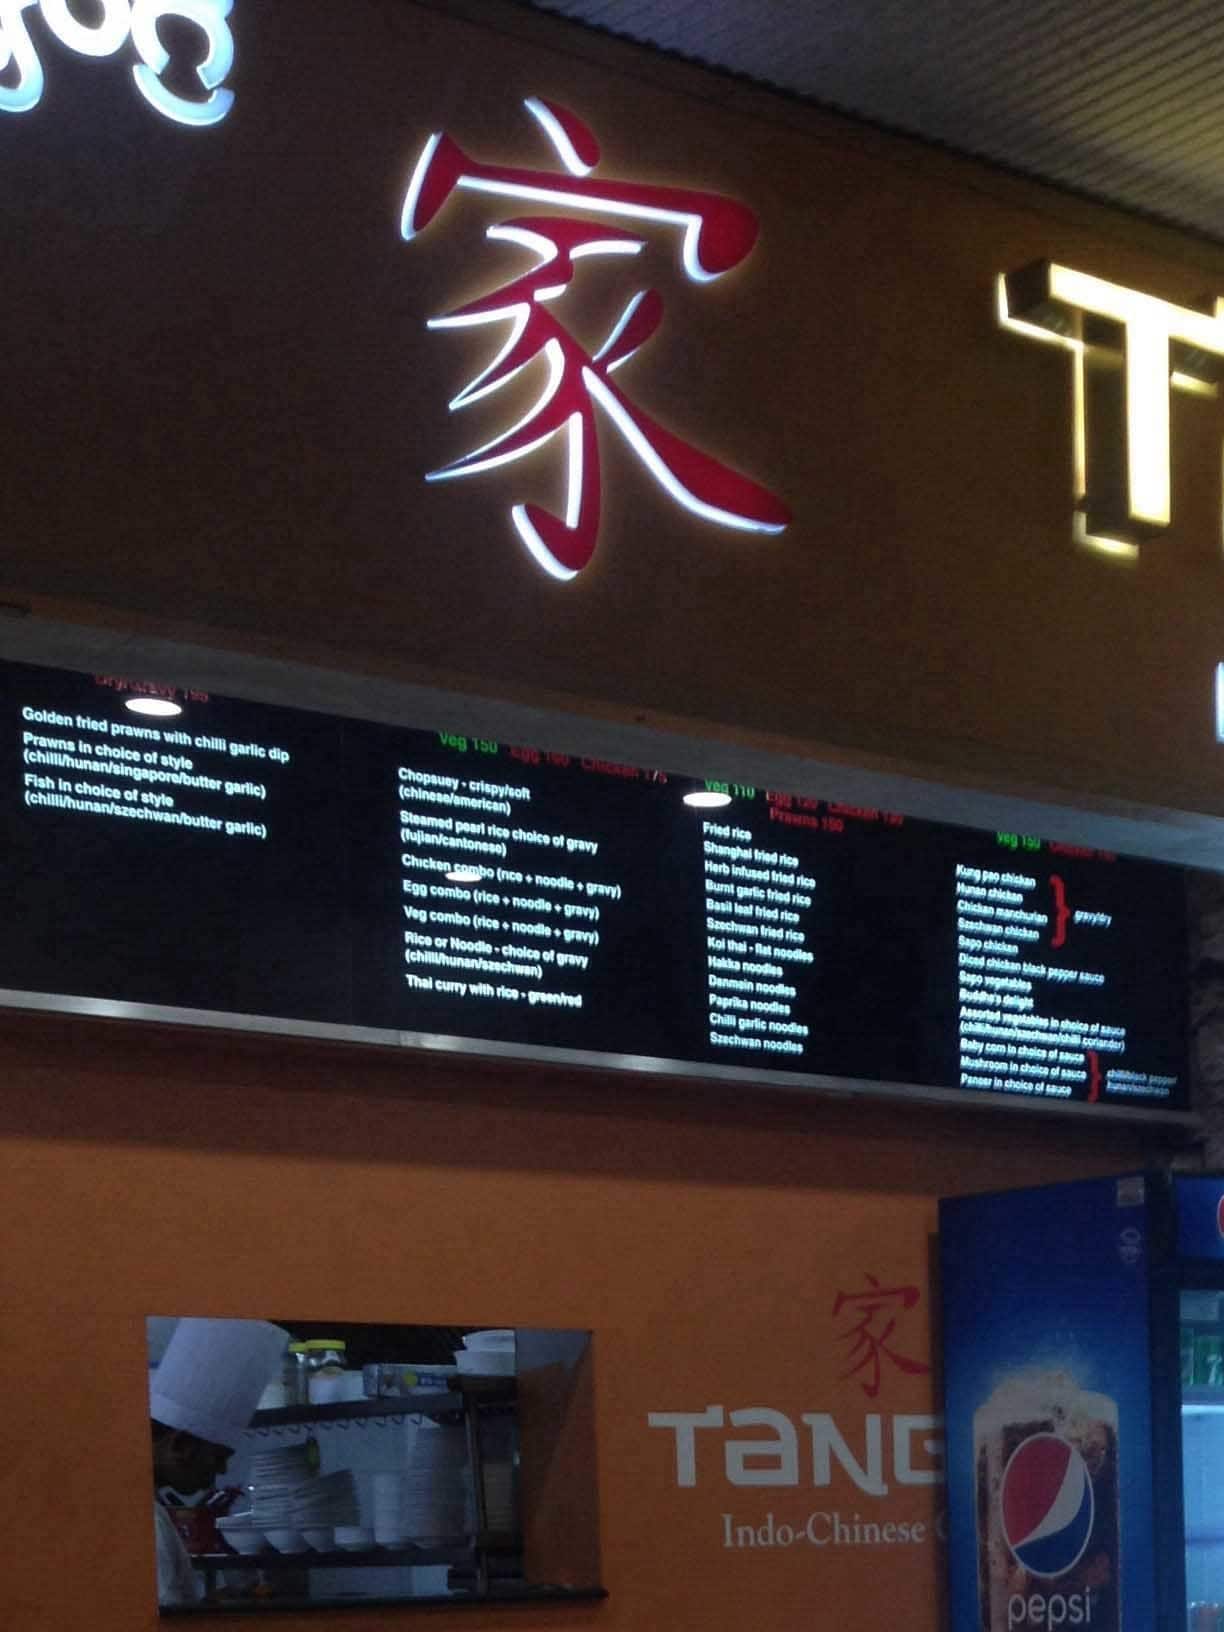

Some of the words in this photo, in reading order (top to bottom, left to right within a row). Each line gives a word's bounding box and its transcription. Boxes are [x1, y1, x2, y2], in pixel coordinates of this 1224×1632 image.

[400, 97, 792, 581] 家
[23, 707, 73, 727] Golden
[75, 716, 108, 732] fried
[110, 724, 160, 743] prawns
[163, 729, 192, 745] with
[194, 734, 226, 751] chilli
[229, 740, 265, 759] garlic
[268, 746, 289, 763] dip
[23, 732, 75, 751] Prawns
[78, 740, 92, 754] in
[94, 743, 140, 761] choice
[143, 750, 157, 763] of
[160, 752, 192, 771] style
[25, 774, 55, 789] Fish
[58, 778, 72, 792] in
[74, 781, 121, 798] choice
[123, 787, 138, 801] of
[140, 790, 173, 808] style
[224, 779, 265, 799] garlic)
[225, 820, 266, 839] garlic)
[833, 1272, 931, 1399] 家
[721, 1511, 926, 1549] Indo-Chinese
[1008, 1585, 1091, 1632] pepsi
